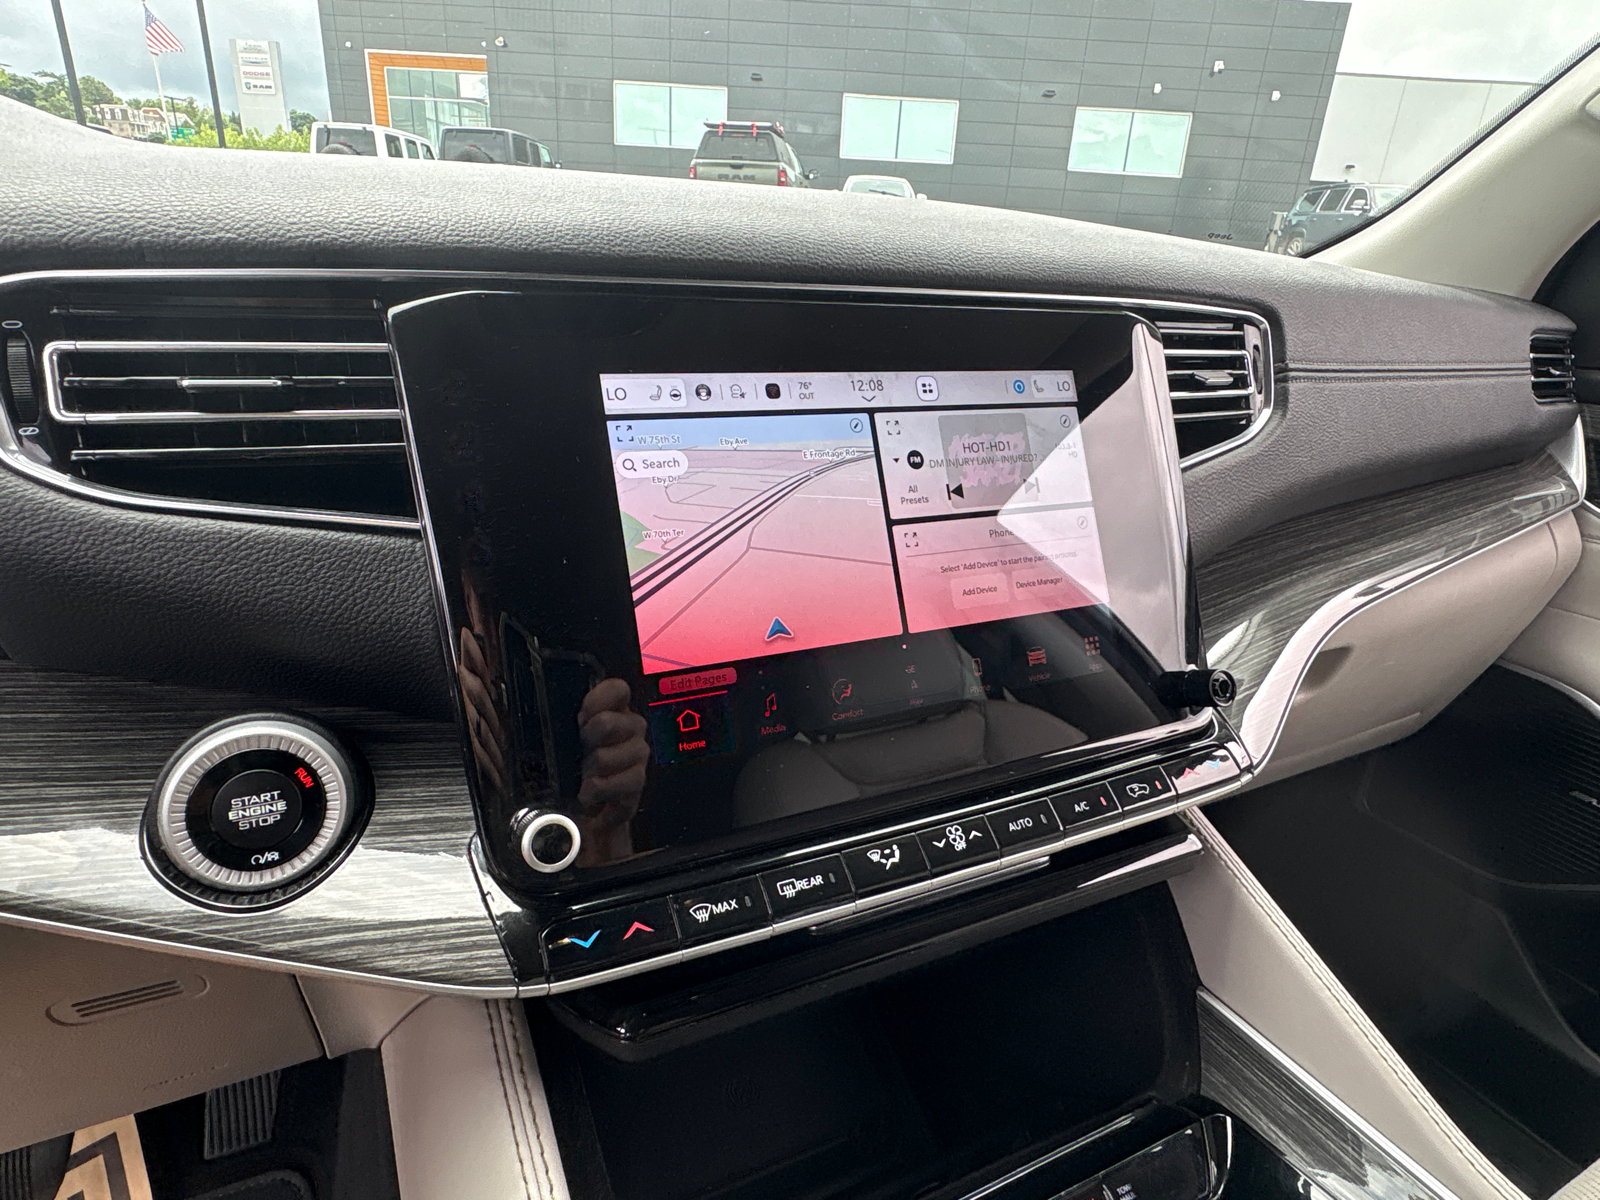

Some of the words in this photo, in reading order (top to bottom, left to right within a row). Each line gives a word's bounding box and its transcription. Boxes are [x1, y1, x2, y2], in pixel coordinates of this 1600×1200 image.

[850, 380, 884, 392] 12:08
[1057, 380, 1071, 392] LO
[606, 387, 627, 400] LO
[798, 392, 814, 400] OUT
[637, 436, 649, 444] W
[650, 435, 669, 444] 75th
[671, 434, 680, 444] St
[720, 438, 732, 446] Eby
[732, 436, 748, 445] Ave
[962, 440, 1011, 454] HOT-HD1
[810, 450, 844, 460] Frontage
[910, 455, 922, 464] FM
[930, 458, 944, 469] DM
[945, 456, 975, 469] INJURY
[977, 456, 996, 466] LAW
[1000, 454, 1038, 465] INJURED?
[642, 457, 680, 470] Search
[652, 475, 664, 486] Eby
[666, 474, 678, 483] Dr
[908, 484, 918, 494] All
[900, 495, 929, 505] Presets
[654, 530, 670, 538] 70th
[672, 529, 684, 537] Ter
[988, 528, 1014, 539] Phone
[940, 564, 960, 574] Select
[1000, 558, 1008, 566] to
[1008, 556, 1022, 566] start
[1023, 556, 1034, 564] the
[1016, 578, 1036, 589] Device
[1037, 576, 1063, 588] Manager
[962, 588, 976, 596] Add
[976, 585, 998, 594] Device
[670, 678, 692, 691] Edit
[695, 672, 727, 689] Pages
[970, 684, 990, 694] Phone
[832, 708, 864, 722] Comfort
[679, 738, 706, 752] Home
[294, 767, 315, 788] RUN
[230, 790, 281, 809] START
[228, 800, 288, 821] ENGINE
[1074, 800, 1090, 813] A/C
[238, 814, 281, 830] STOP
[1008, 817, 1033, 832] AUTO
[954, 842, 967, 852] OFF
[796, 874, 824, 889] REAR
[712, 898, 738, 915] MAX
